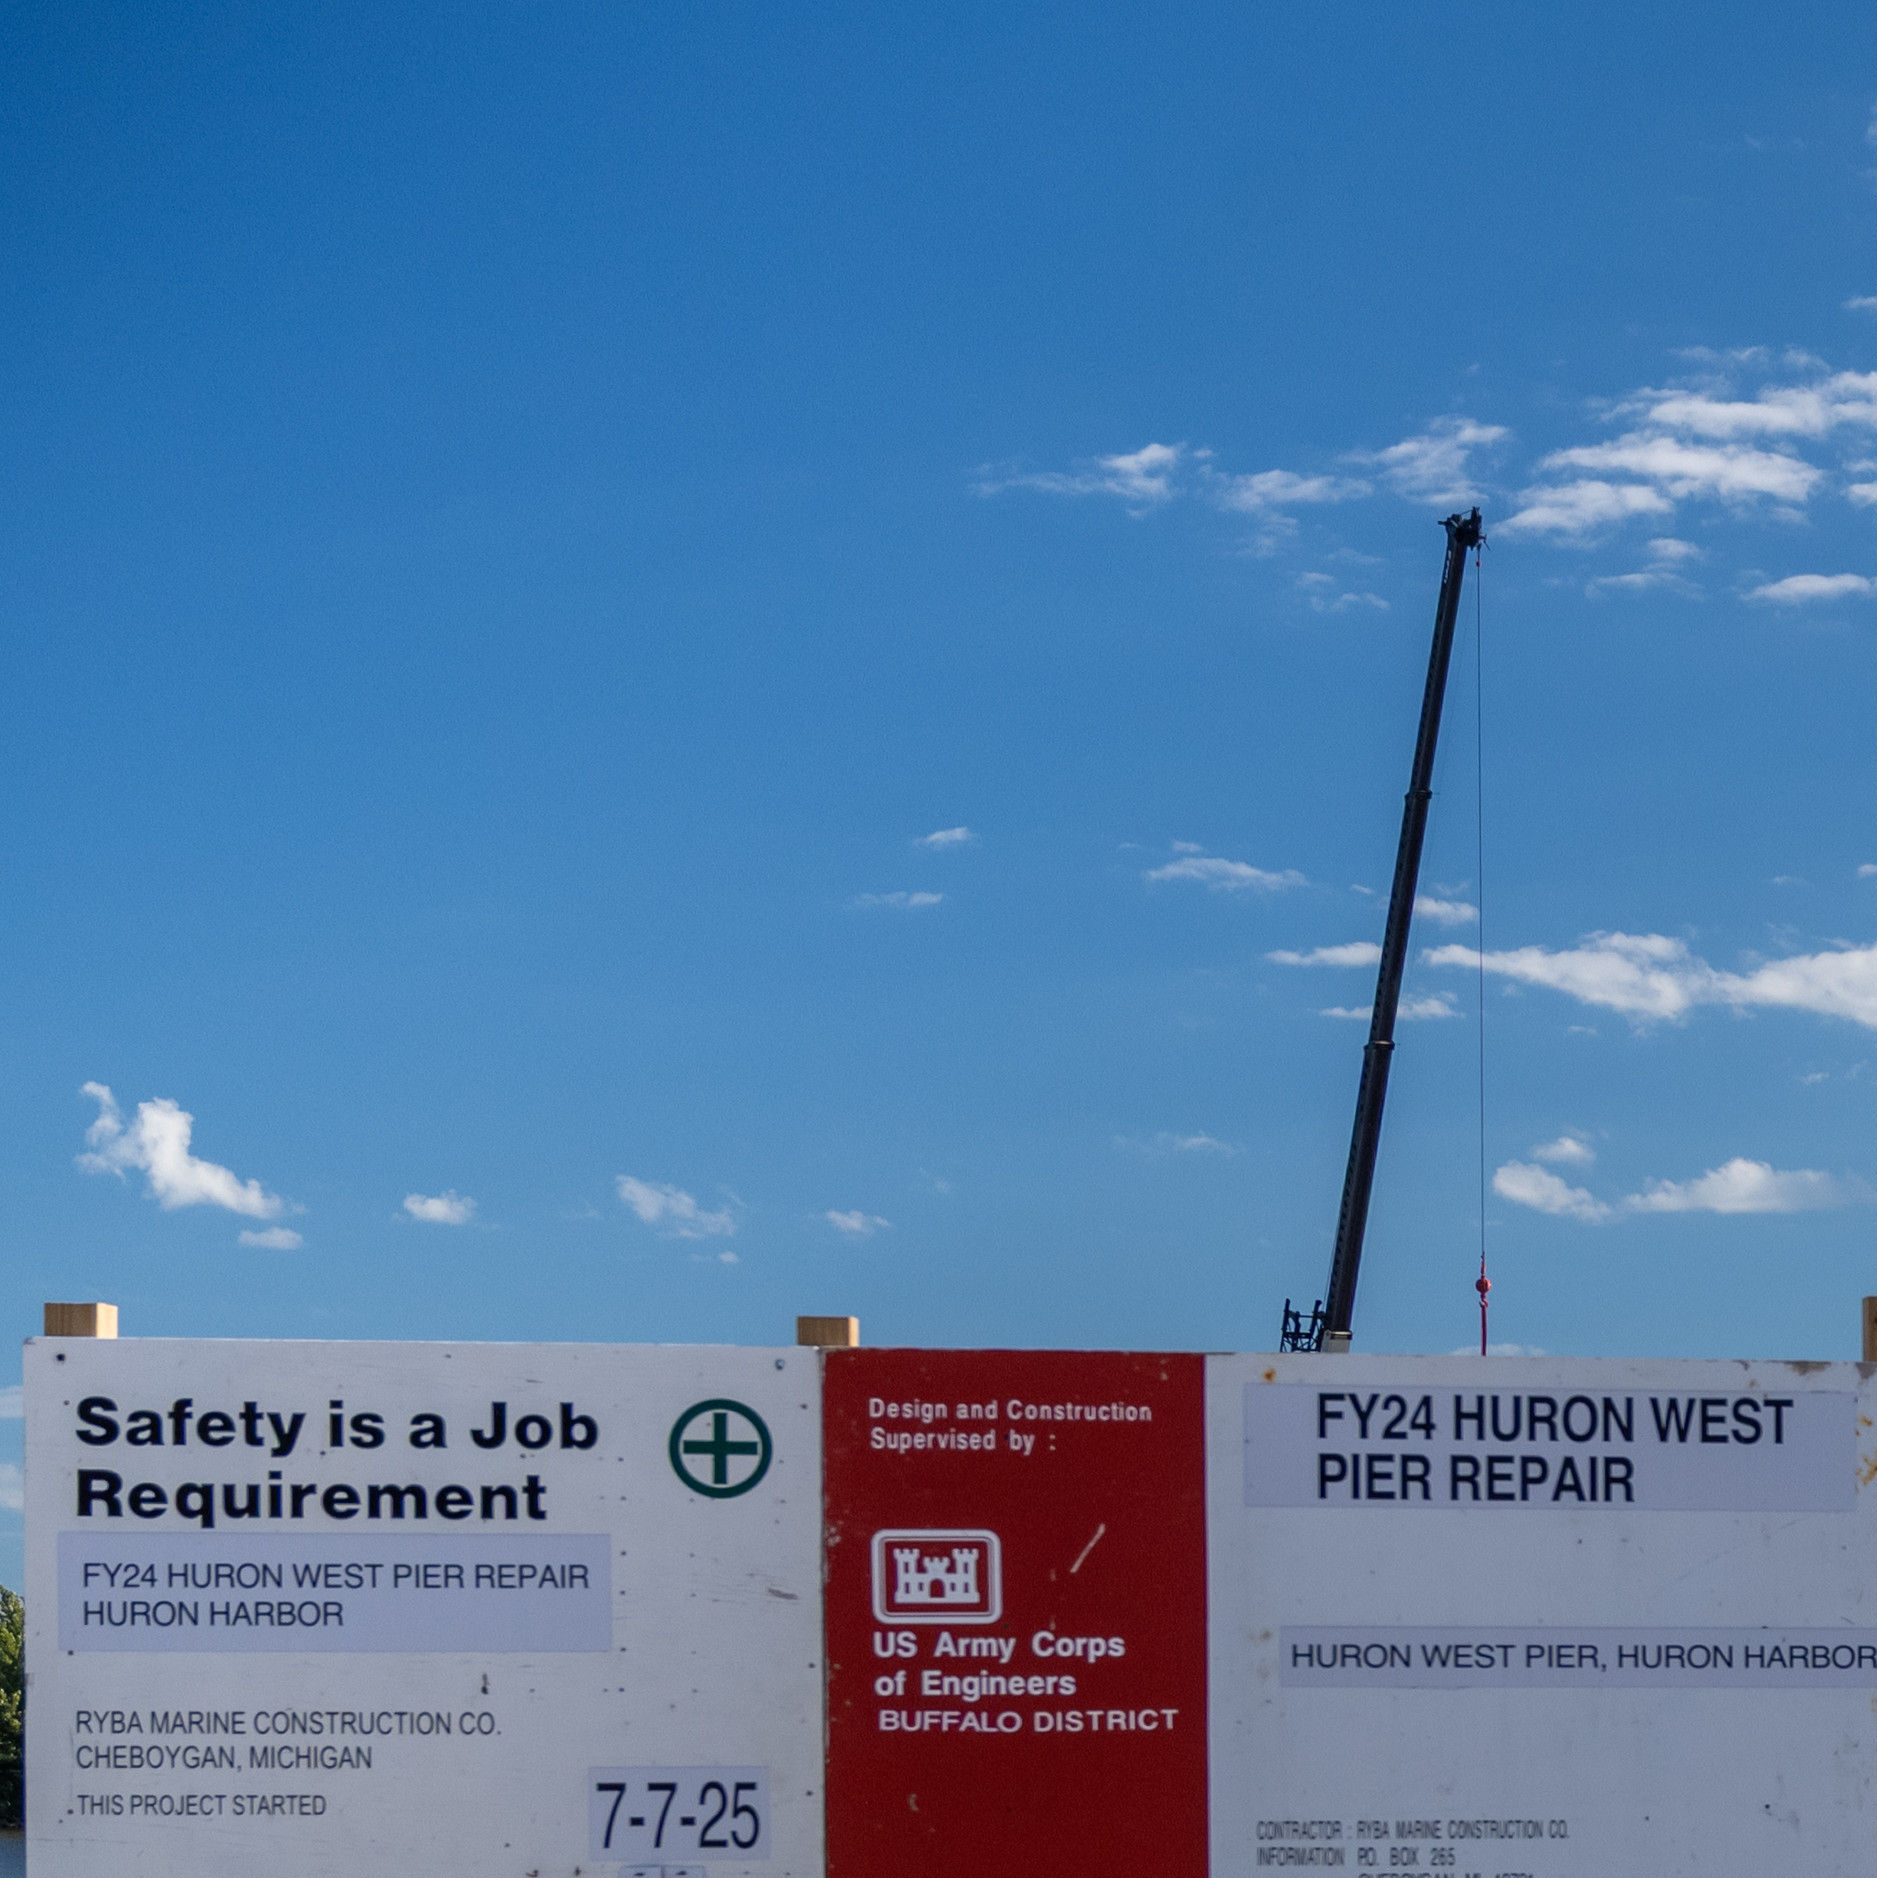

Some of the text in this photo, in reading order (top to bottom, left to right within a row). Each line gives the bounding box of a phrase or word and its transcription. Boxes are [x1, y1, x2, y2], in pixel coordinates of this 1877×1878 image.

[869, 1398, 1151, 1423] Design and Construction
[1318, 1393, 1793, 1444] FY24 HURON WEST
[76, 1397, 598, 1457] Safety is a Job
[871, 1427, 995, 1454] Supervised
[1010, 1429, 1035, 1455] by
[1318, 1453, 1634, 1502] PIER REPAIR
[77, 1469, 546, 1528] Requirement
[84, 1563, 588, 1589] FY24 HURON WEST PIER REPAIR
[84, 1601, 343, 1627] HURON HARBOR
[874, 1631, 1125, 1663] US Army Corps
[1292, 1644, 1877, 1671] HURON WEST PIER, HURON HARBOR
[875, 1670, 1076, 1702] of Engineers
[76, 1711, 501, 1735] RYBA MARINE CONSTRUCTION CO.
[879, 1709, 1178, 1732] BUFFALO DISTRICT
[76, 1745, 371, 1770] CHEBOYGAN, MICHIGAN
[77, 1795, 326, 1815] THIS PROJECT STARTED
[596, 1781, 759, 1850] 7-7-25
[1257, 1821, 1342, 1840] CONTRACTOR
[1357, 1820, 1389, 1839] RYBA
[1396, 1820, 1442, 1839] MARINE
[1448, 1820, 1543, 1839] CONSTRUCTION
[1257, 1847, 1344, 1866] INFORMATION
[1390, 1847, 1418, 1866] BOX
[1430, 1847, 1455, 1866] 265
